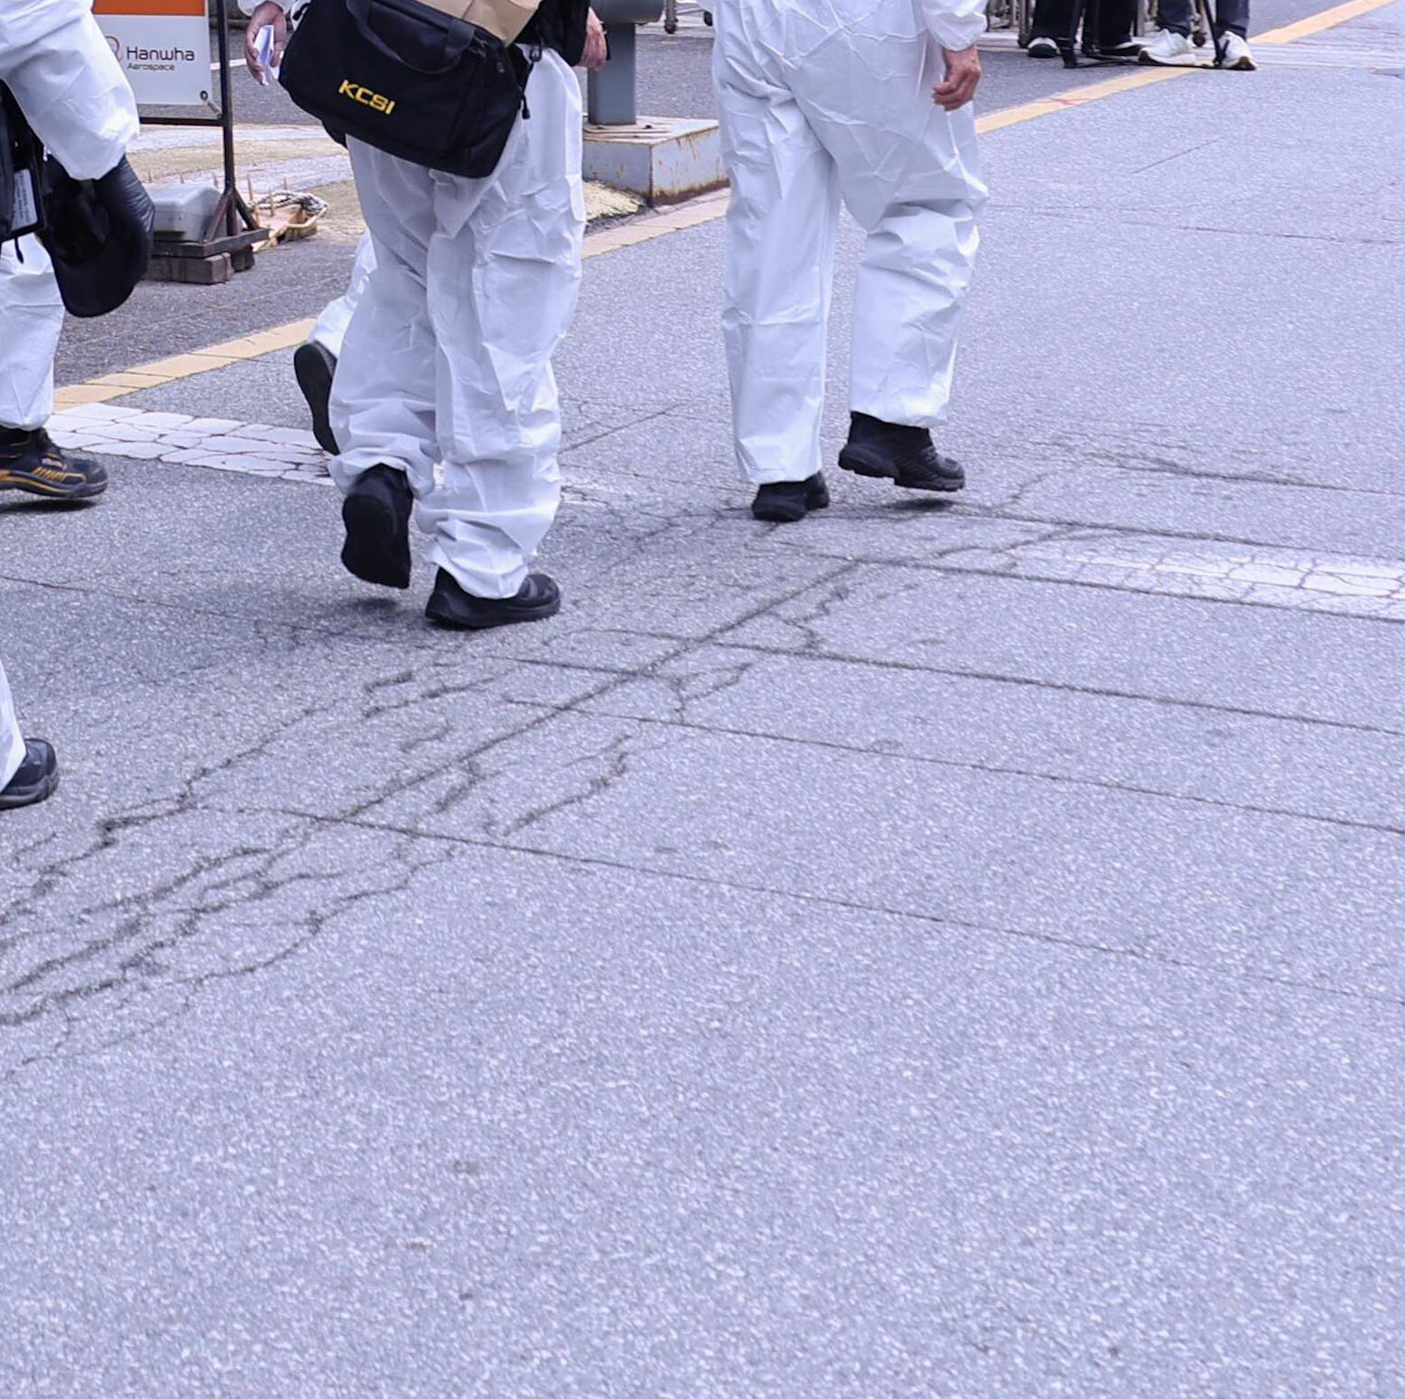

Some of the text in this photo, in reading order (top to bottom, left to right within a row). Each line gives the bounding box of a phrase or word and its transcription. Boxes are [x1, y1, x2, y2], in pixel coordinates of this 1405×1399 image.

[126, 46, 195, 61] Hanwha
[127, 62, 176, 71] Aerospace
[338, 79, 397, 115] KCSI
